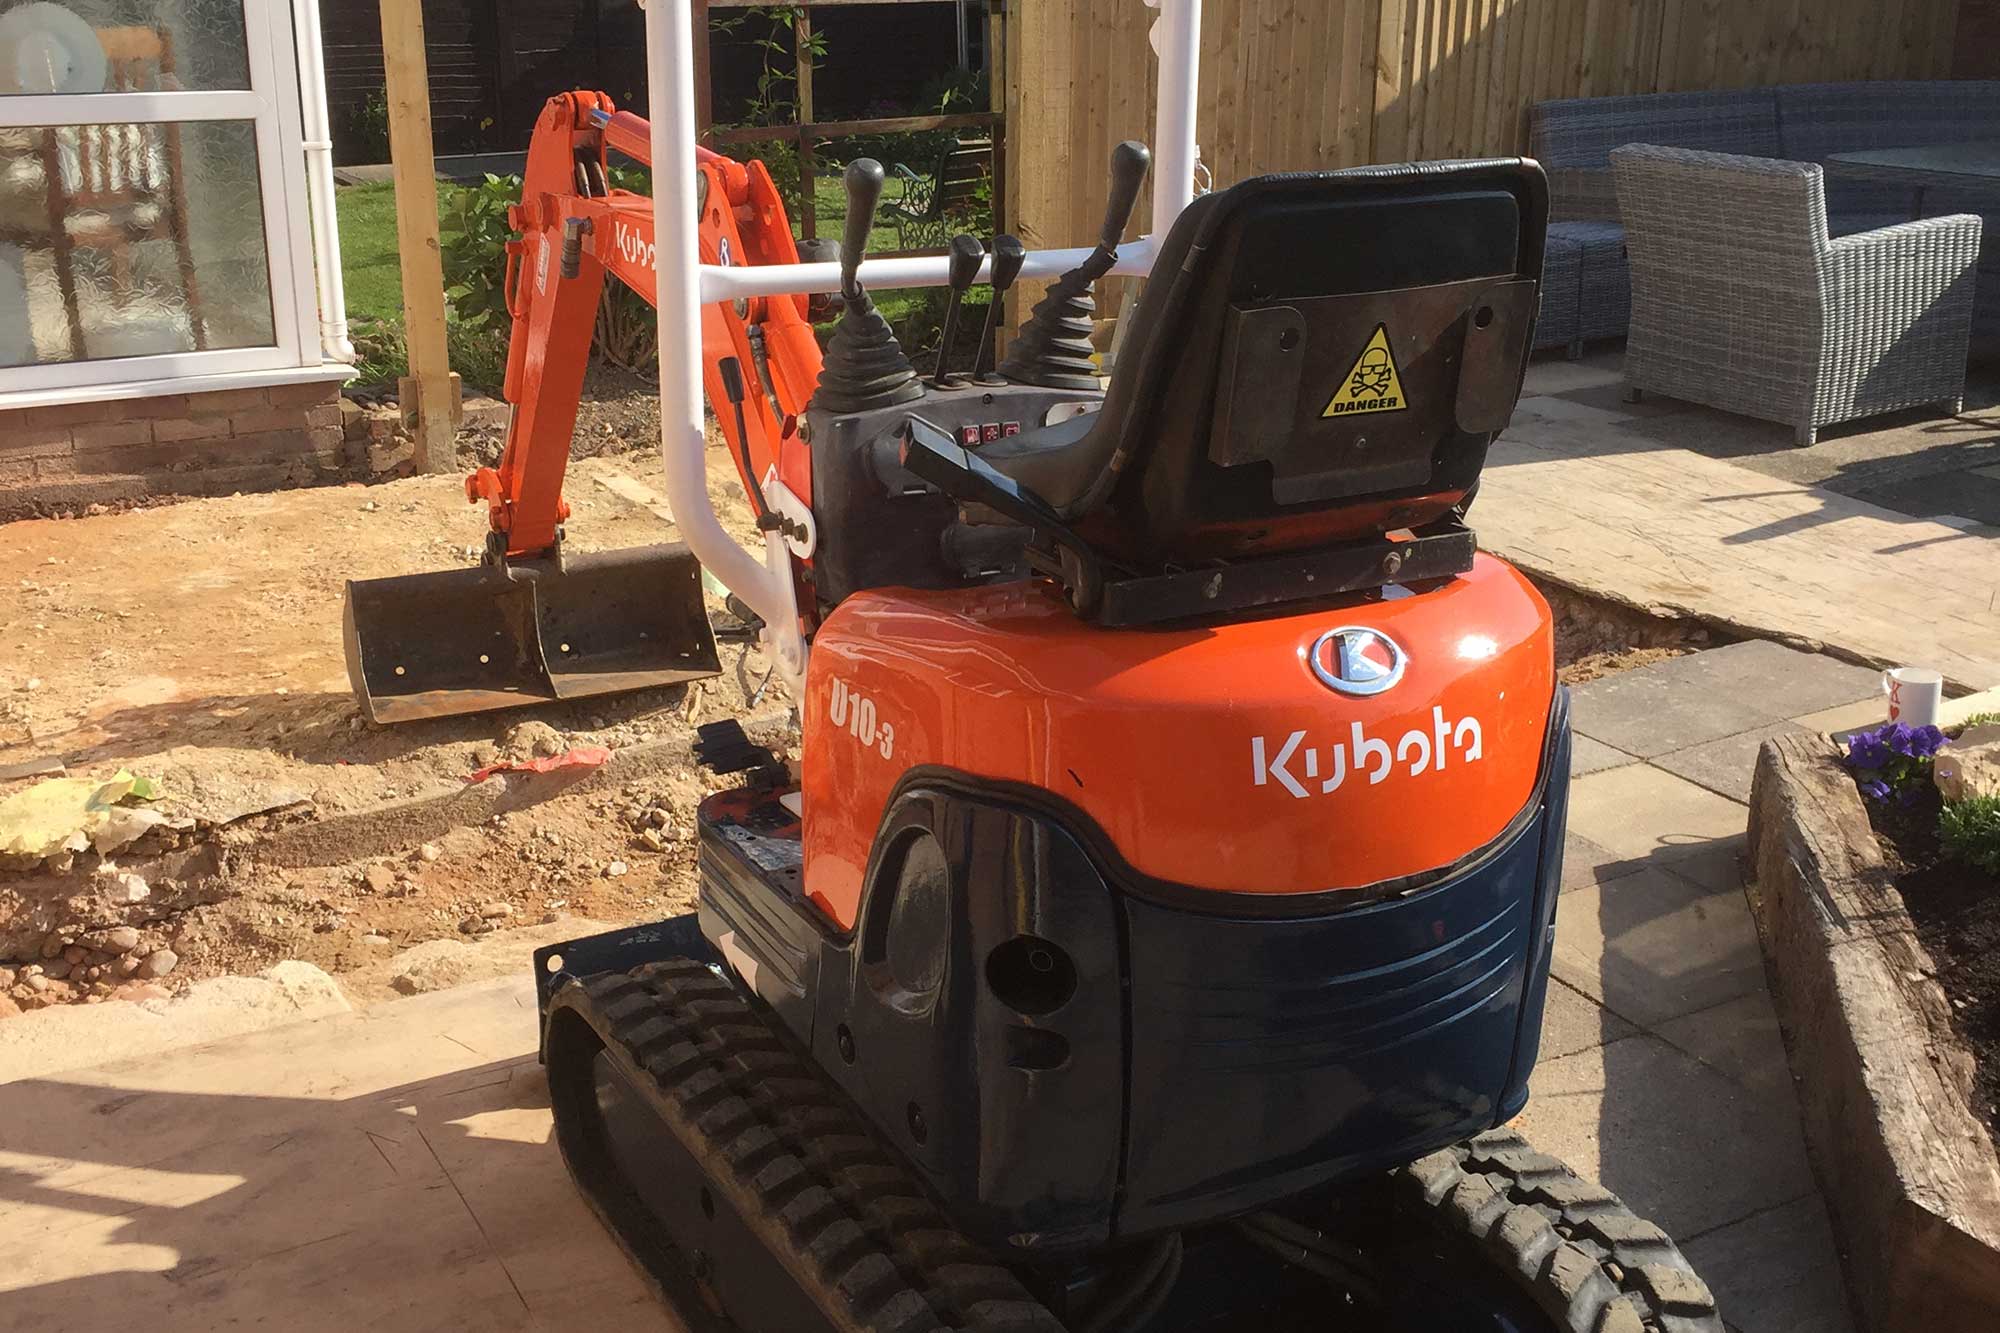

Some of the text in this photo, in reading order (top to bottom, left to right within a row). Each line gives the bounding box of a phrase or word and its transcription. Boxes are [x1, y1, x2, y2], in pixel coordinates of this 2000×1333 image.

[1333, 397, 1398, 413] DANGER
[830, 676, 894, 760] U10-3
[1252, 705, 1482, 798] Kubota
